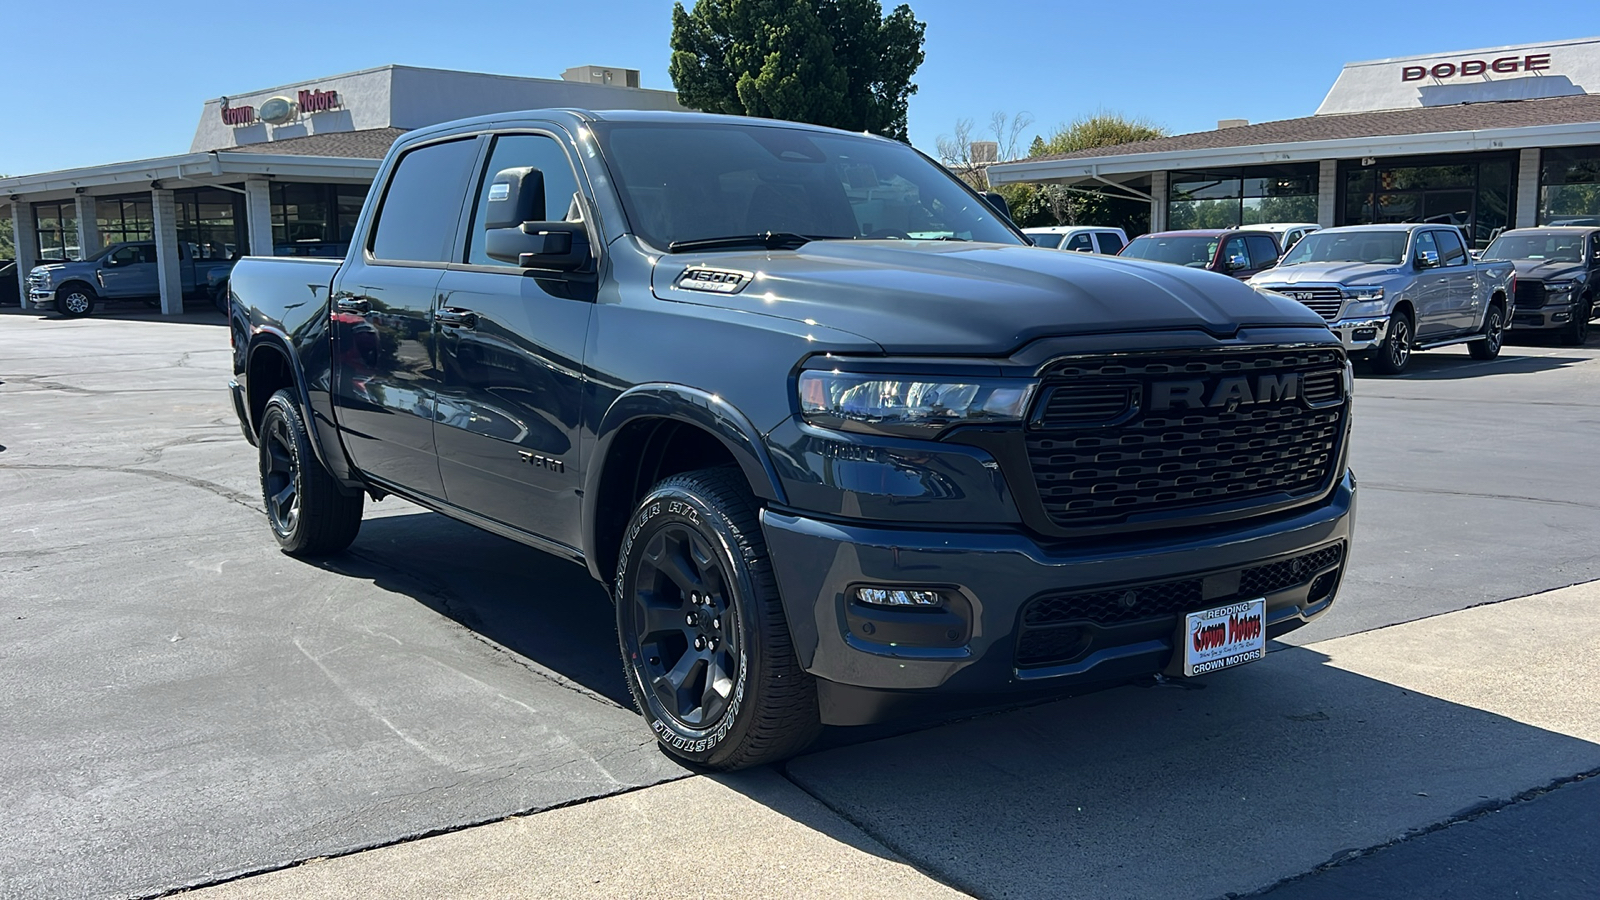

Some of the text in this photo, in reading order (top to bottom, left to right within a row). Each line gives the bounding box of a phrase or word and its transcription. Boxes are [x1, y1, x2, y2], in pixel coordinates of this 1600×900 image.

[1402, 53, 1551, 82] DODGE
[221, 102, 255, 125] Crown
[298, 89, 338, 113] Motors
[690, 270, 740, 284] 1500
[1150, 373, 1298, 410] RAM
[1207, 603, 1248, 619] REDDING
[1193, 613, 1262, 653] Crown Motors
[1193, 650, 1260, 674] CROWN MOTORS
[652, 649, 748, 752] BRIDGESTONE
